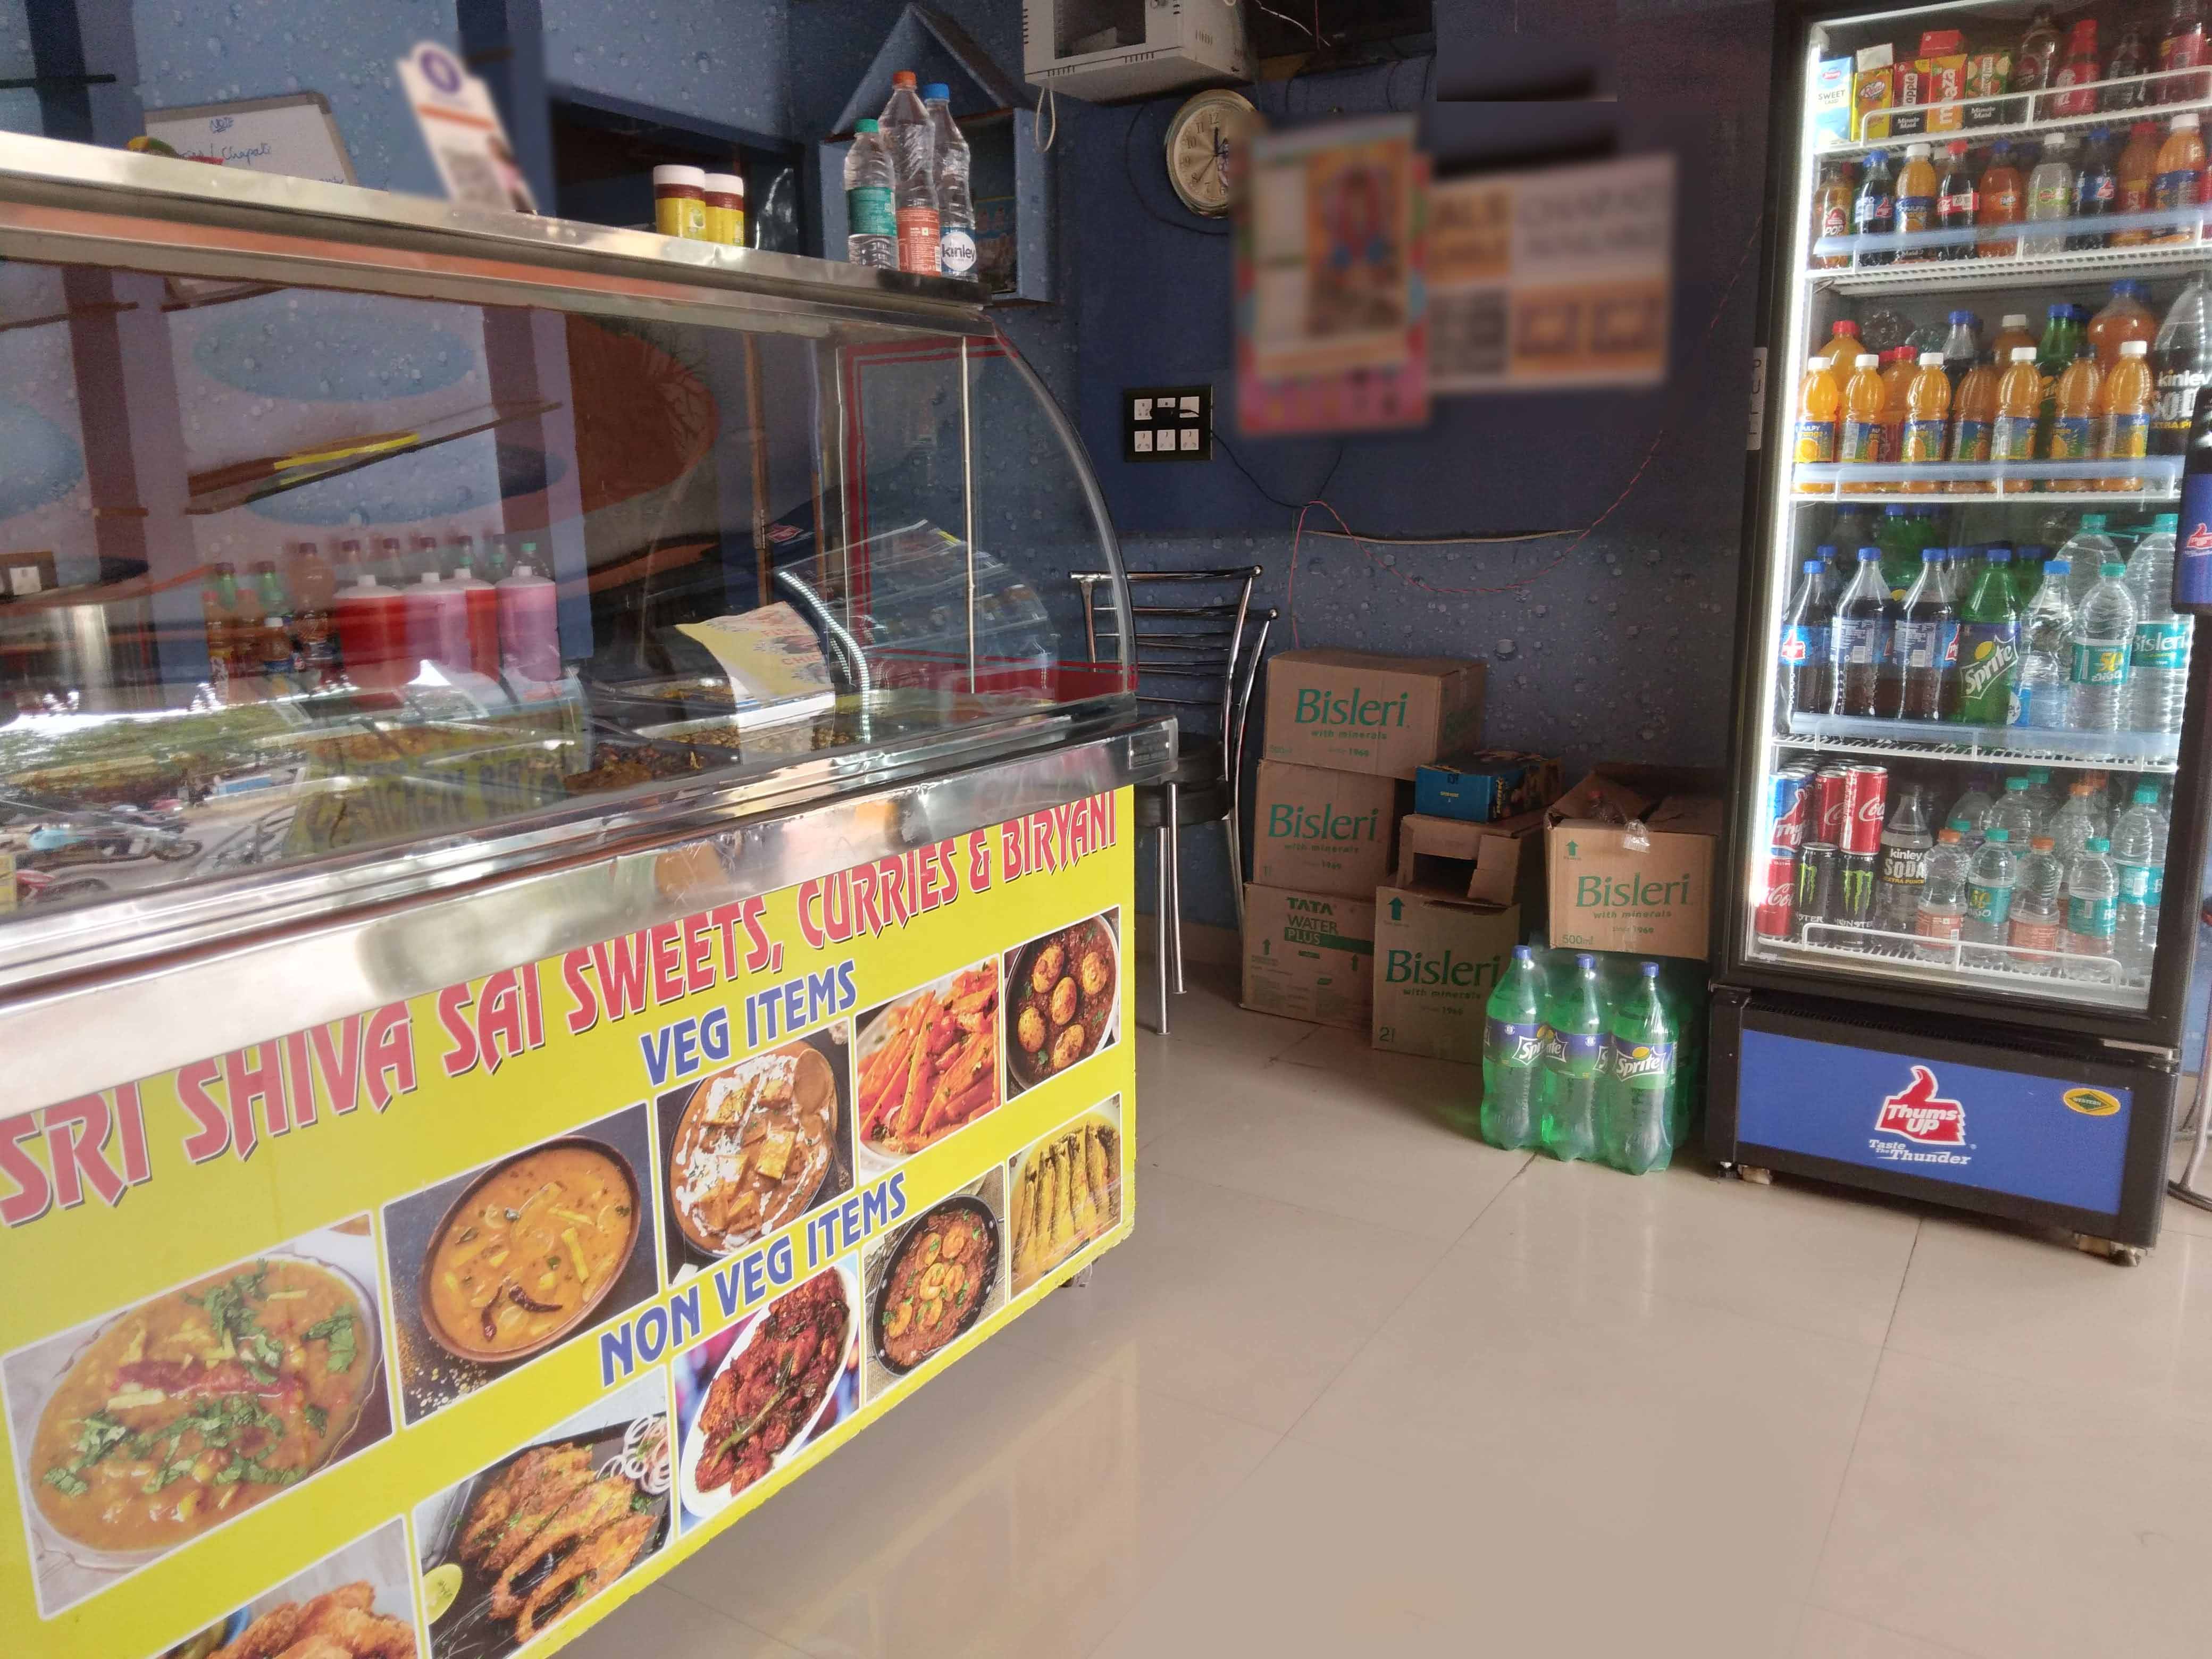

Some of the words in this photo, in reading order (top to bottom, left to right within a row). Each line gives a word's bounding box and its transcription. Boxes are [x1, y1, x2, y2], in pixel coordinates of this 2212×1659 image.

[1818, 89, 1846, 100] SWEET
[1906, 75, 1915, 104] apple
[941, 244, 976, 261] kinley
[1964, 644, 2013, 696] Sprite
[1294, 688, 1409, 727] Bisleri
[1311, 730, 1334, 738] with
[1338, 730, 1387, 740] minerals
[1268, 803, 1379, 842] Bisleri
[1890, 848, 1924, 862] kinley
[1883, 858, 1927, 879] SODA
[1576, 872, 1691, 908] Bisleri
[1286, 896, 1334, 916] TATA
[1593, 910, 1617, 919] with
[1621, 910, 1672, 919] minerals
[1288, 914, 1338, 935] WATER
[1288, 928, 1321, 946] PLUS
[1561, 934, 1594, 945] 500ml
[1385, 949, 1502, 988] Bisleri
[0, 1079, 152, 1228] SRI
[177, 1000, 419, 1162] SHIVA
[435, 961, 548, 1077] SAI
[563, 897, 784, 1035] SWEETS,
[796, 842, 959, 950] CURRIES
[968, 828, 993, 893] &
[1002, 789, 1117, 884] BIRYANI
[640, 1006, 730, 1087] VEG
[744, 959, 858, 1050] ITEMS
[1616, 1053, 1661, 1078] Sprite
[1887, 1104, 1959, 1121] Thums
[1869, 1139, 1906, 1150] Taste
[1889, 1149, 1972, 1165] Thunder
[599, 1285, 702, 1389] NON
[713, 1234, 794, 1321] VEG
[805, 1170, 907, 1269] ITEMS
